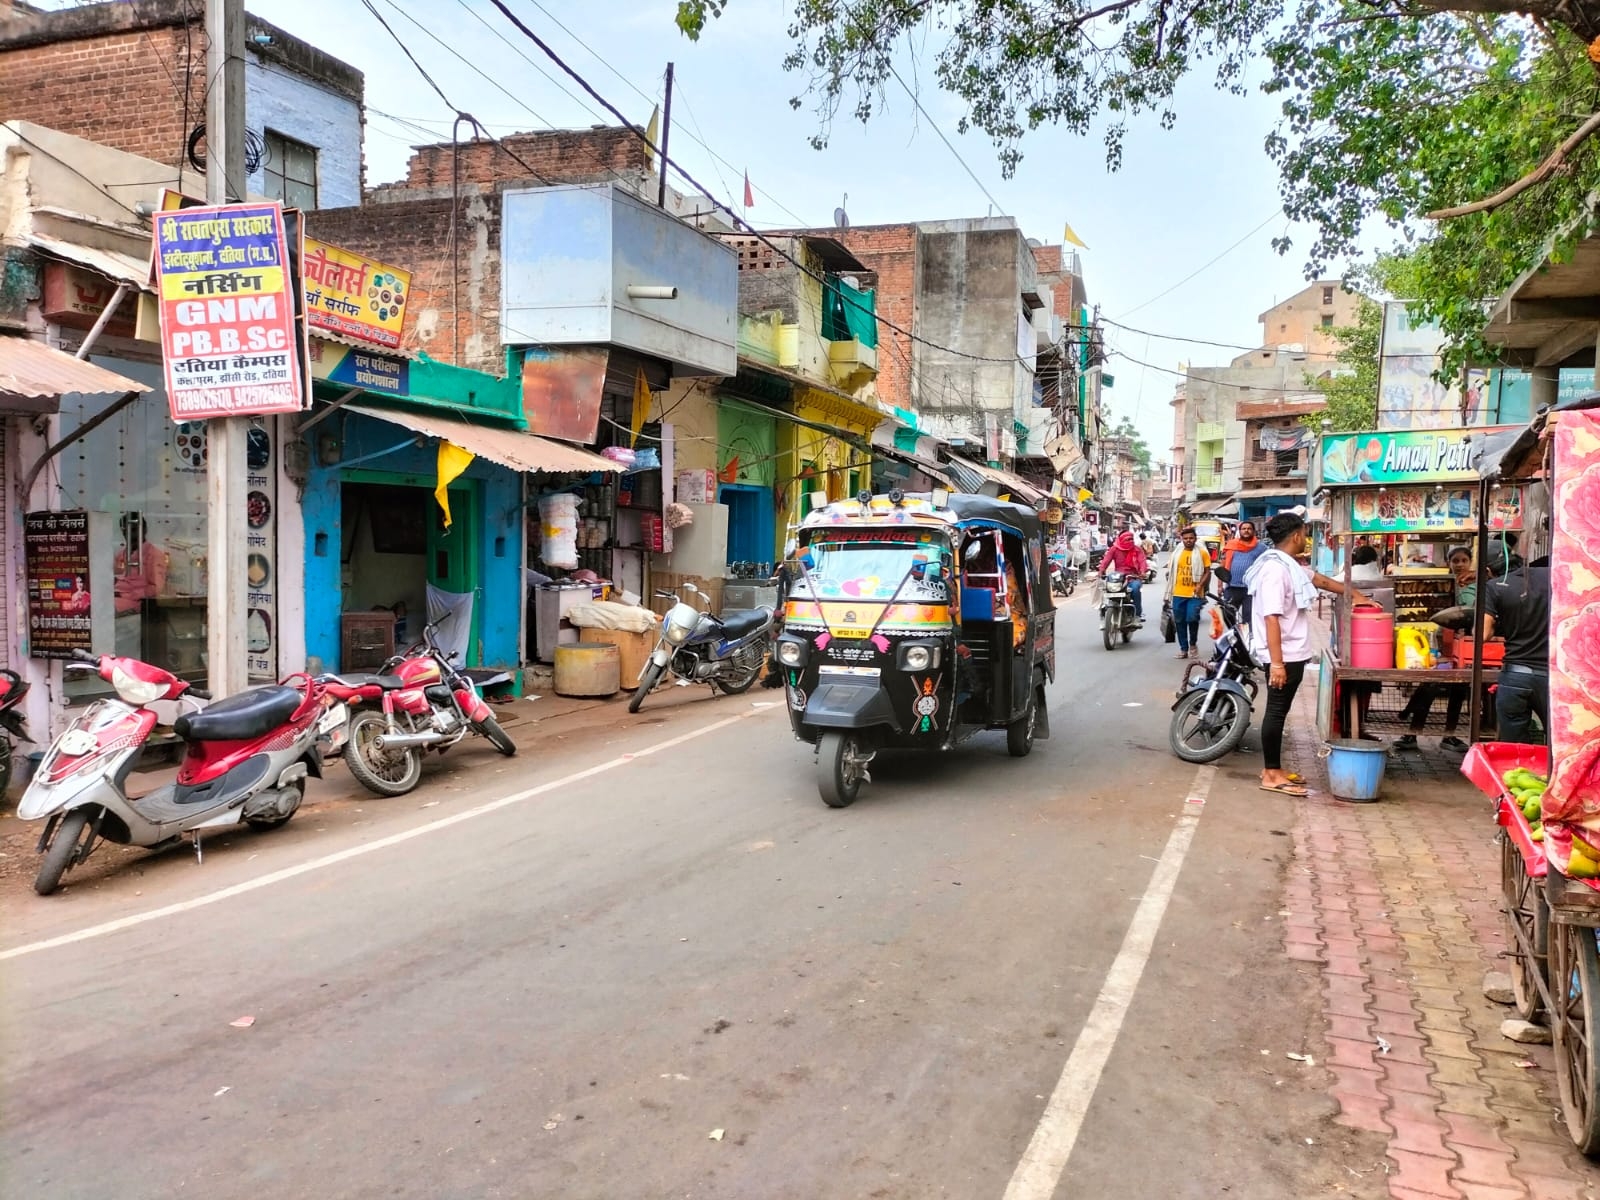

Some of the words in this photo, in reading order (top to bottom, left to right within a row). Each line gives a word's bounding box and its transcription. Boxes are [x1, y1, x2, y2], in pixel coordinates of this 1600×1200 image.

[162, 217, 178, 242] श्री
[180, 219, 231, 245] रावतपुरा
[232, 215, 274, 237] सरकार
[218, 245, 246, 264] दतिया
[183, 271, 263, 295] नर्सिंग
[175, 295, 277, 326] GNM
[172, 326, 286, 356] PB.B.Sc
[174, 358, 228, 373] दतिया
[232, 355, 287, 370] कैम्पस
[1383, 438, 1431, 472] Aman
[1436, 436, 1472, 471] Pati
